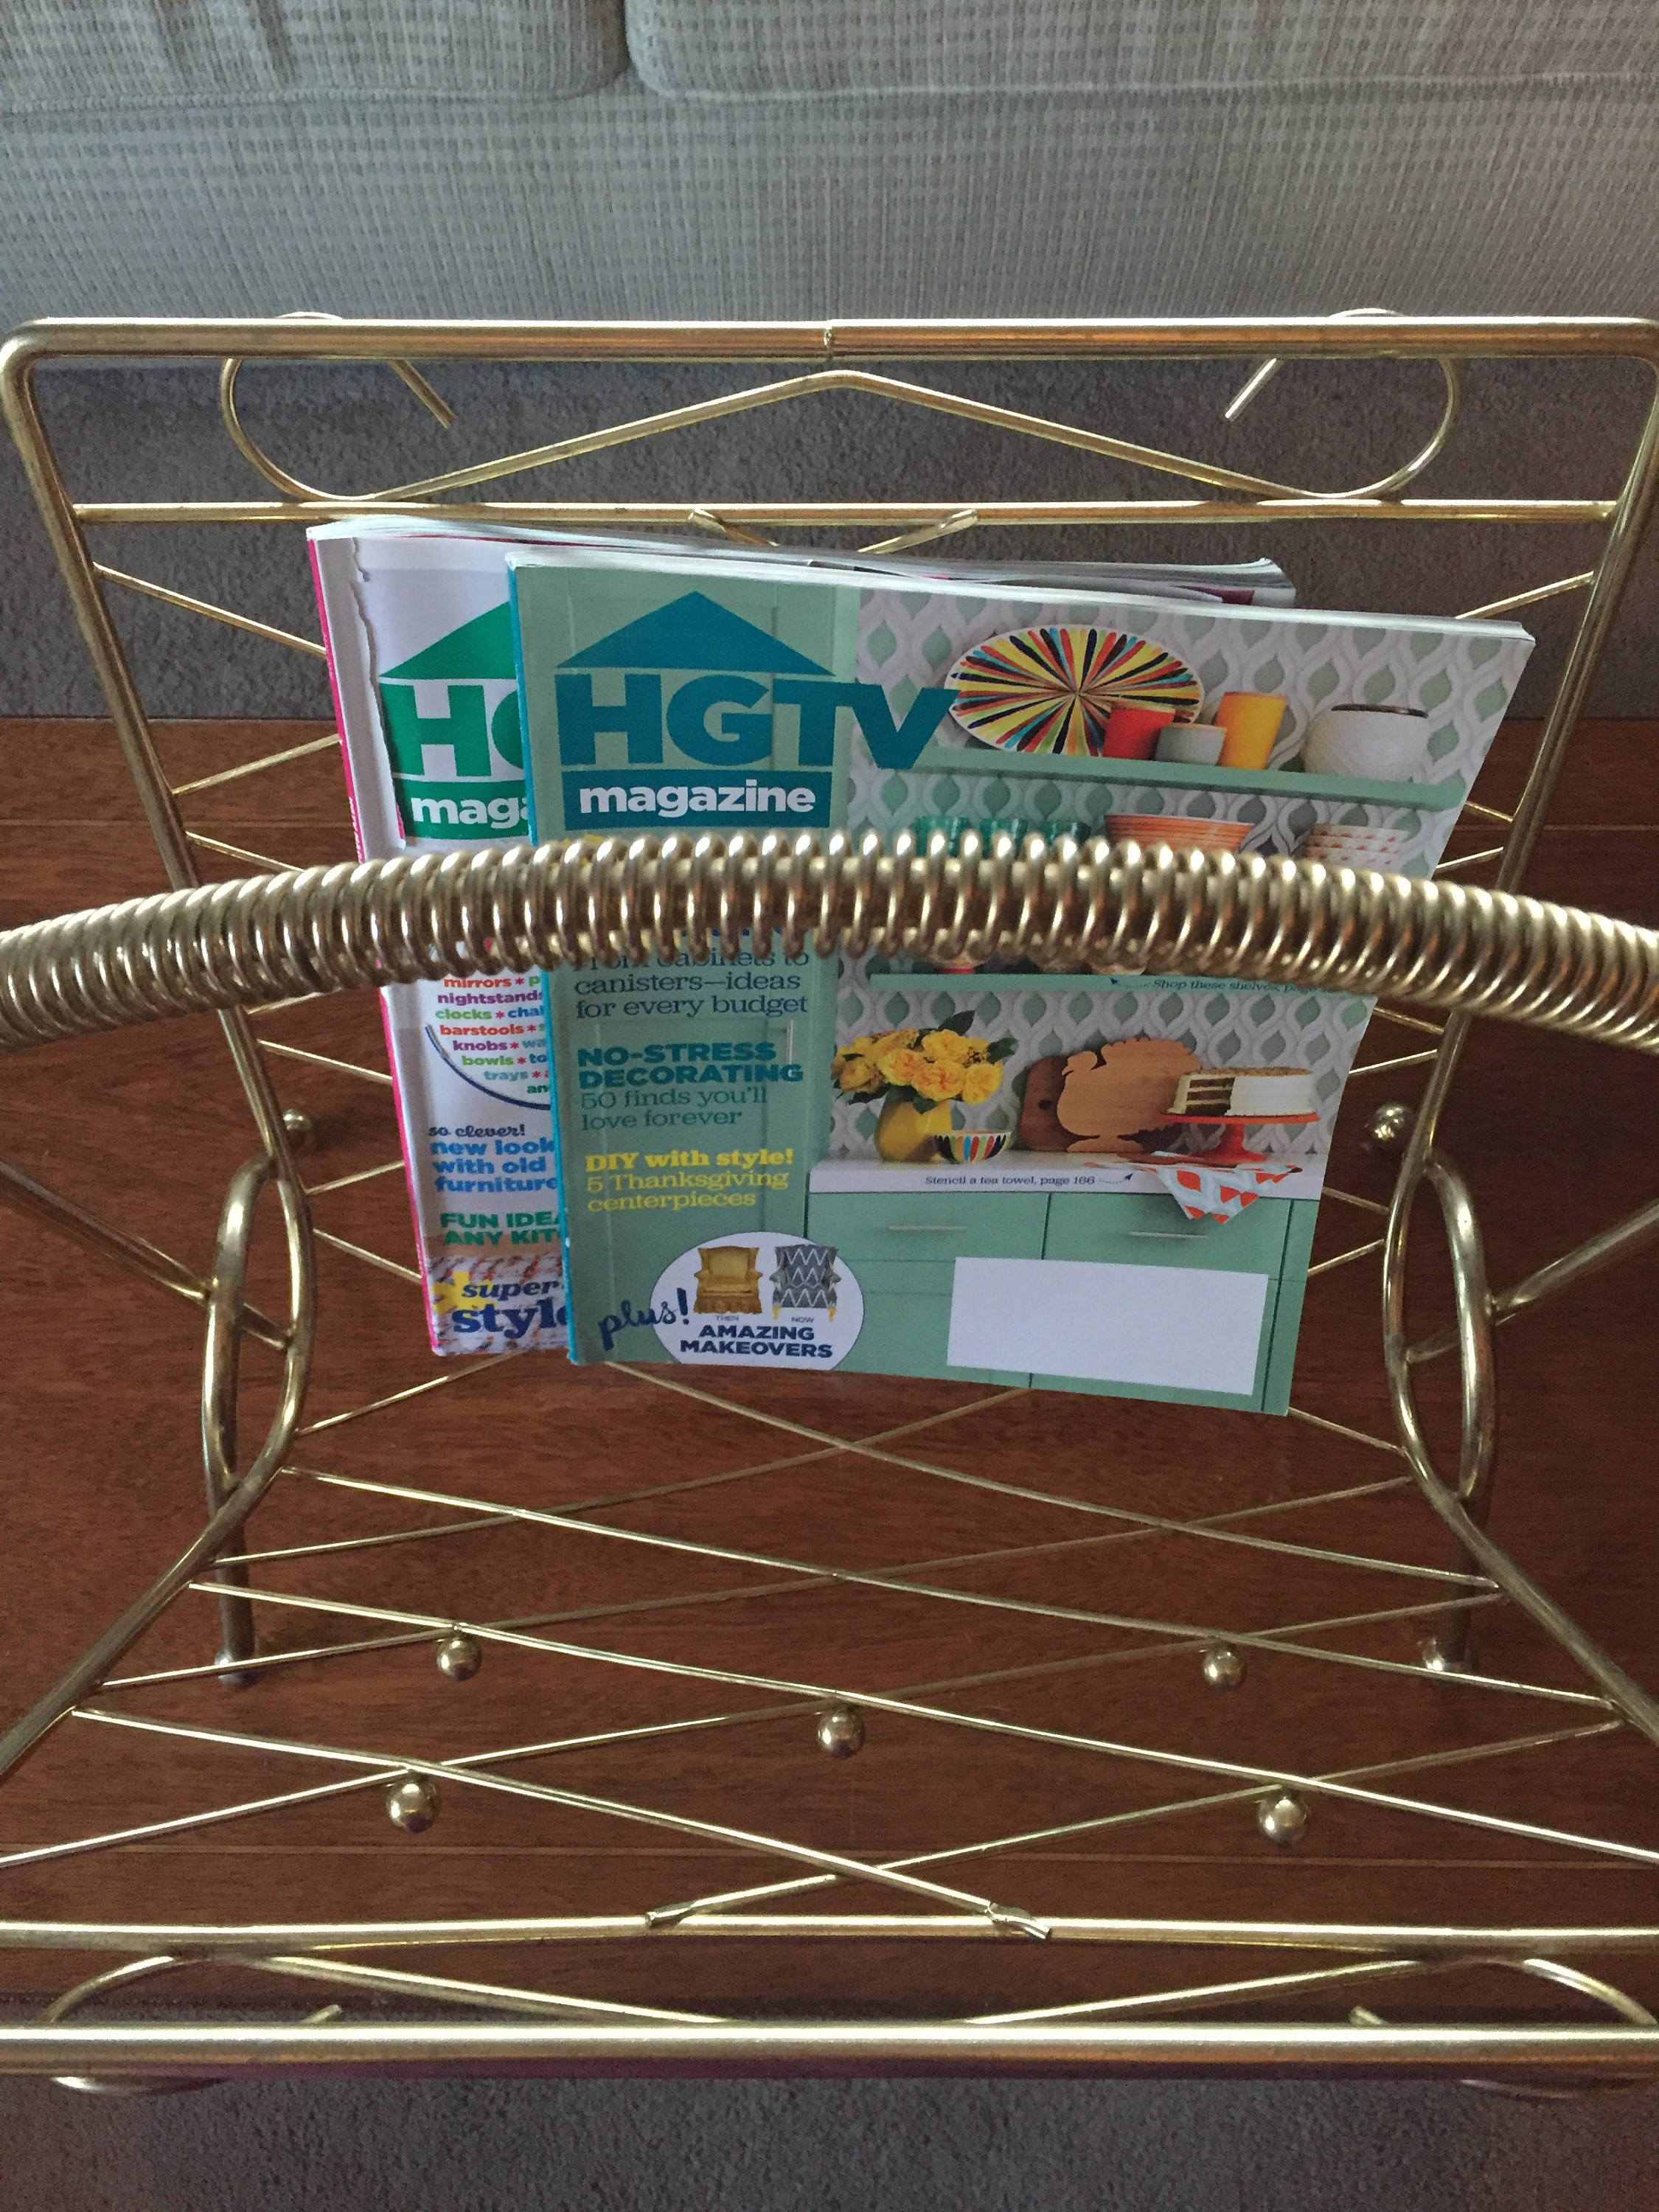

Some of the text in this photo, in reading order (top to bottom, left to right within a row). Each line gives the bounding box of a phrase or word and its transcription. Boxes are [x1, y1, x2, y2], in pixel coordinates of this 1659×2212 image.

[554, 672, 959, 771] HGTV
[579, 778, 816, 818] magazine
[444, 977, 512, 988] mirrors
[1153, 979, 1187, 990] Shop
[1191, 981, 1225, 991] these
[1228, 981, 1281, 993] shelves,
[435, 1009, 493, 1020] clocks
[575, 995, 809, 1019] for every budget
[439, 1023, 524, 1036] barstools
[453, 1040, 508, 1051] knobs
[462, 1055, 514, 1065] bowls
[577, 1042, 776, 1067] NO-STRESS
[483, 1071, 528, 1082] trays
[578, 1064, 804, 1090] DECORATING
[580, 1086, 768, 1110] 50 finds you'll
[581, 1109, 742, 1131] love forever
[428, 1124, 526, 1138] so clever!
[431, 1141, 487, 1155] new
[433, 1156, 547, 1174] with old
[585, 1148, 794, 1172] DIY with style!
[586, 1170, 790, 1194] 5 Thanksgiving
[925, 1176, 966, 1186] Stencil
[980, 1177, 998, 1186] tea
[1001, 1176, 1037, 1186] towel,
[1039, 1178, 1070, 1186] page
[1073, 1176, 1096, 1186] 166
[587, 1191, 757, 1212] centerpieces
[440, 1211, 560, 1228] FUN IDE
[443, 1228, 561, 1245] ANY KIT
[597, 1287, 690, 1352] plus!
[698, 1324, 815, 1341] AMAZING
[680, 1340, 832, 1358] MAKEOVERS
